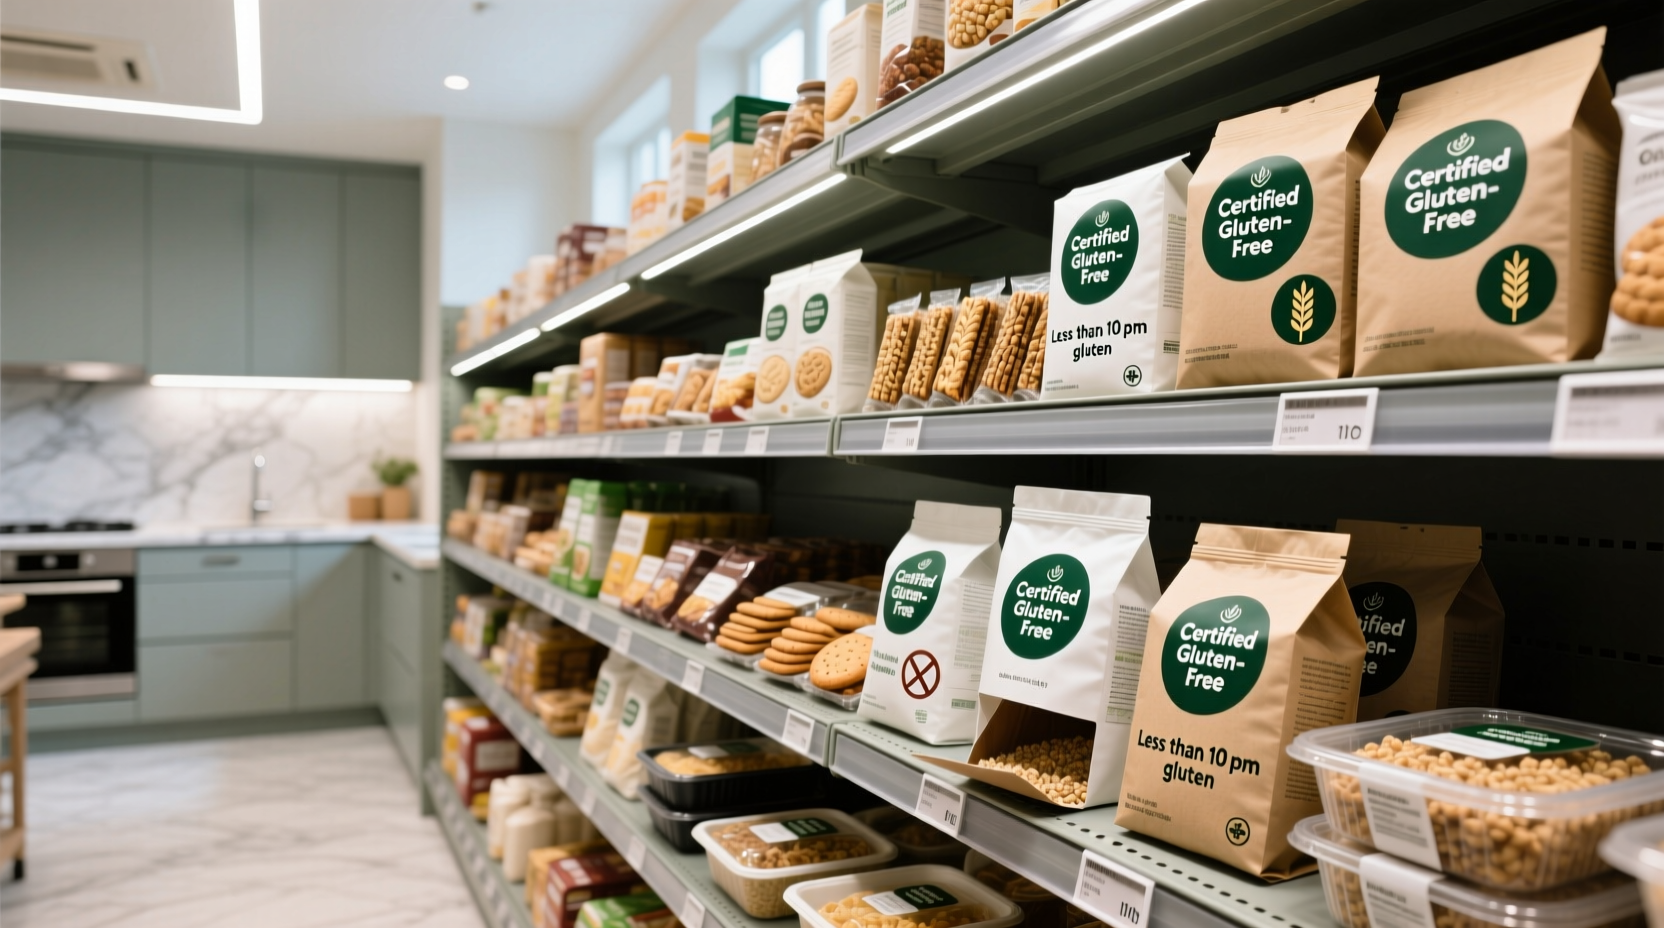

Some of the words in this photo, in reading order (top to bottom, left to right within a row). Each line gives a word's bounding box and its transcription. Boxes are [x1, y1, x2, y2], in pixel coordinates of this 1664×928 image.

[1404, 147, 1511, 190] Certified
[1218, 184, 1300, 218] Certified
[1405, 181, 1499, 214] Gluten-
[1218, 214, 1292, 239] Gluten-
[1423, 208, 1477, 234] Free
[1071, 225, 1130, 252] Certified
[1231, 238, 1273, 258] Free
[1071, 250, 1123, 270] Gluten-
[1080, 268, 1110, 285] Free
[1051, 329, 1073, 343] Less
[1076, 324, 1103, 339] than
[1107, 319, 1121, 336] 10
[1124, 321, 1148, 338] pm
[1073, 343, 1112, 362] gluten
[1016, 581, 1082, 606] Certified
[1013, 600, 1070, 623] Gluten-
[1020, 619, 1053, 640] Free
[1180, 622, 1259, 650] Certified
[1176, 644, 1245, 671] Gluten-
[1184, 667, 1225, 692] Free
[1137, 729, 1166, 753] Less
[1169, 738, 1204, 762] than
[1209, 746, 1228, 767] 10
[1229, 755, 1261, 776] pm
[1162, 761, 1215, 789] gluten
